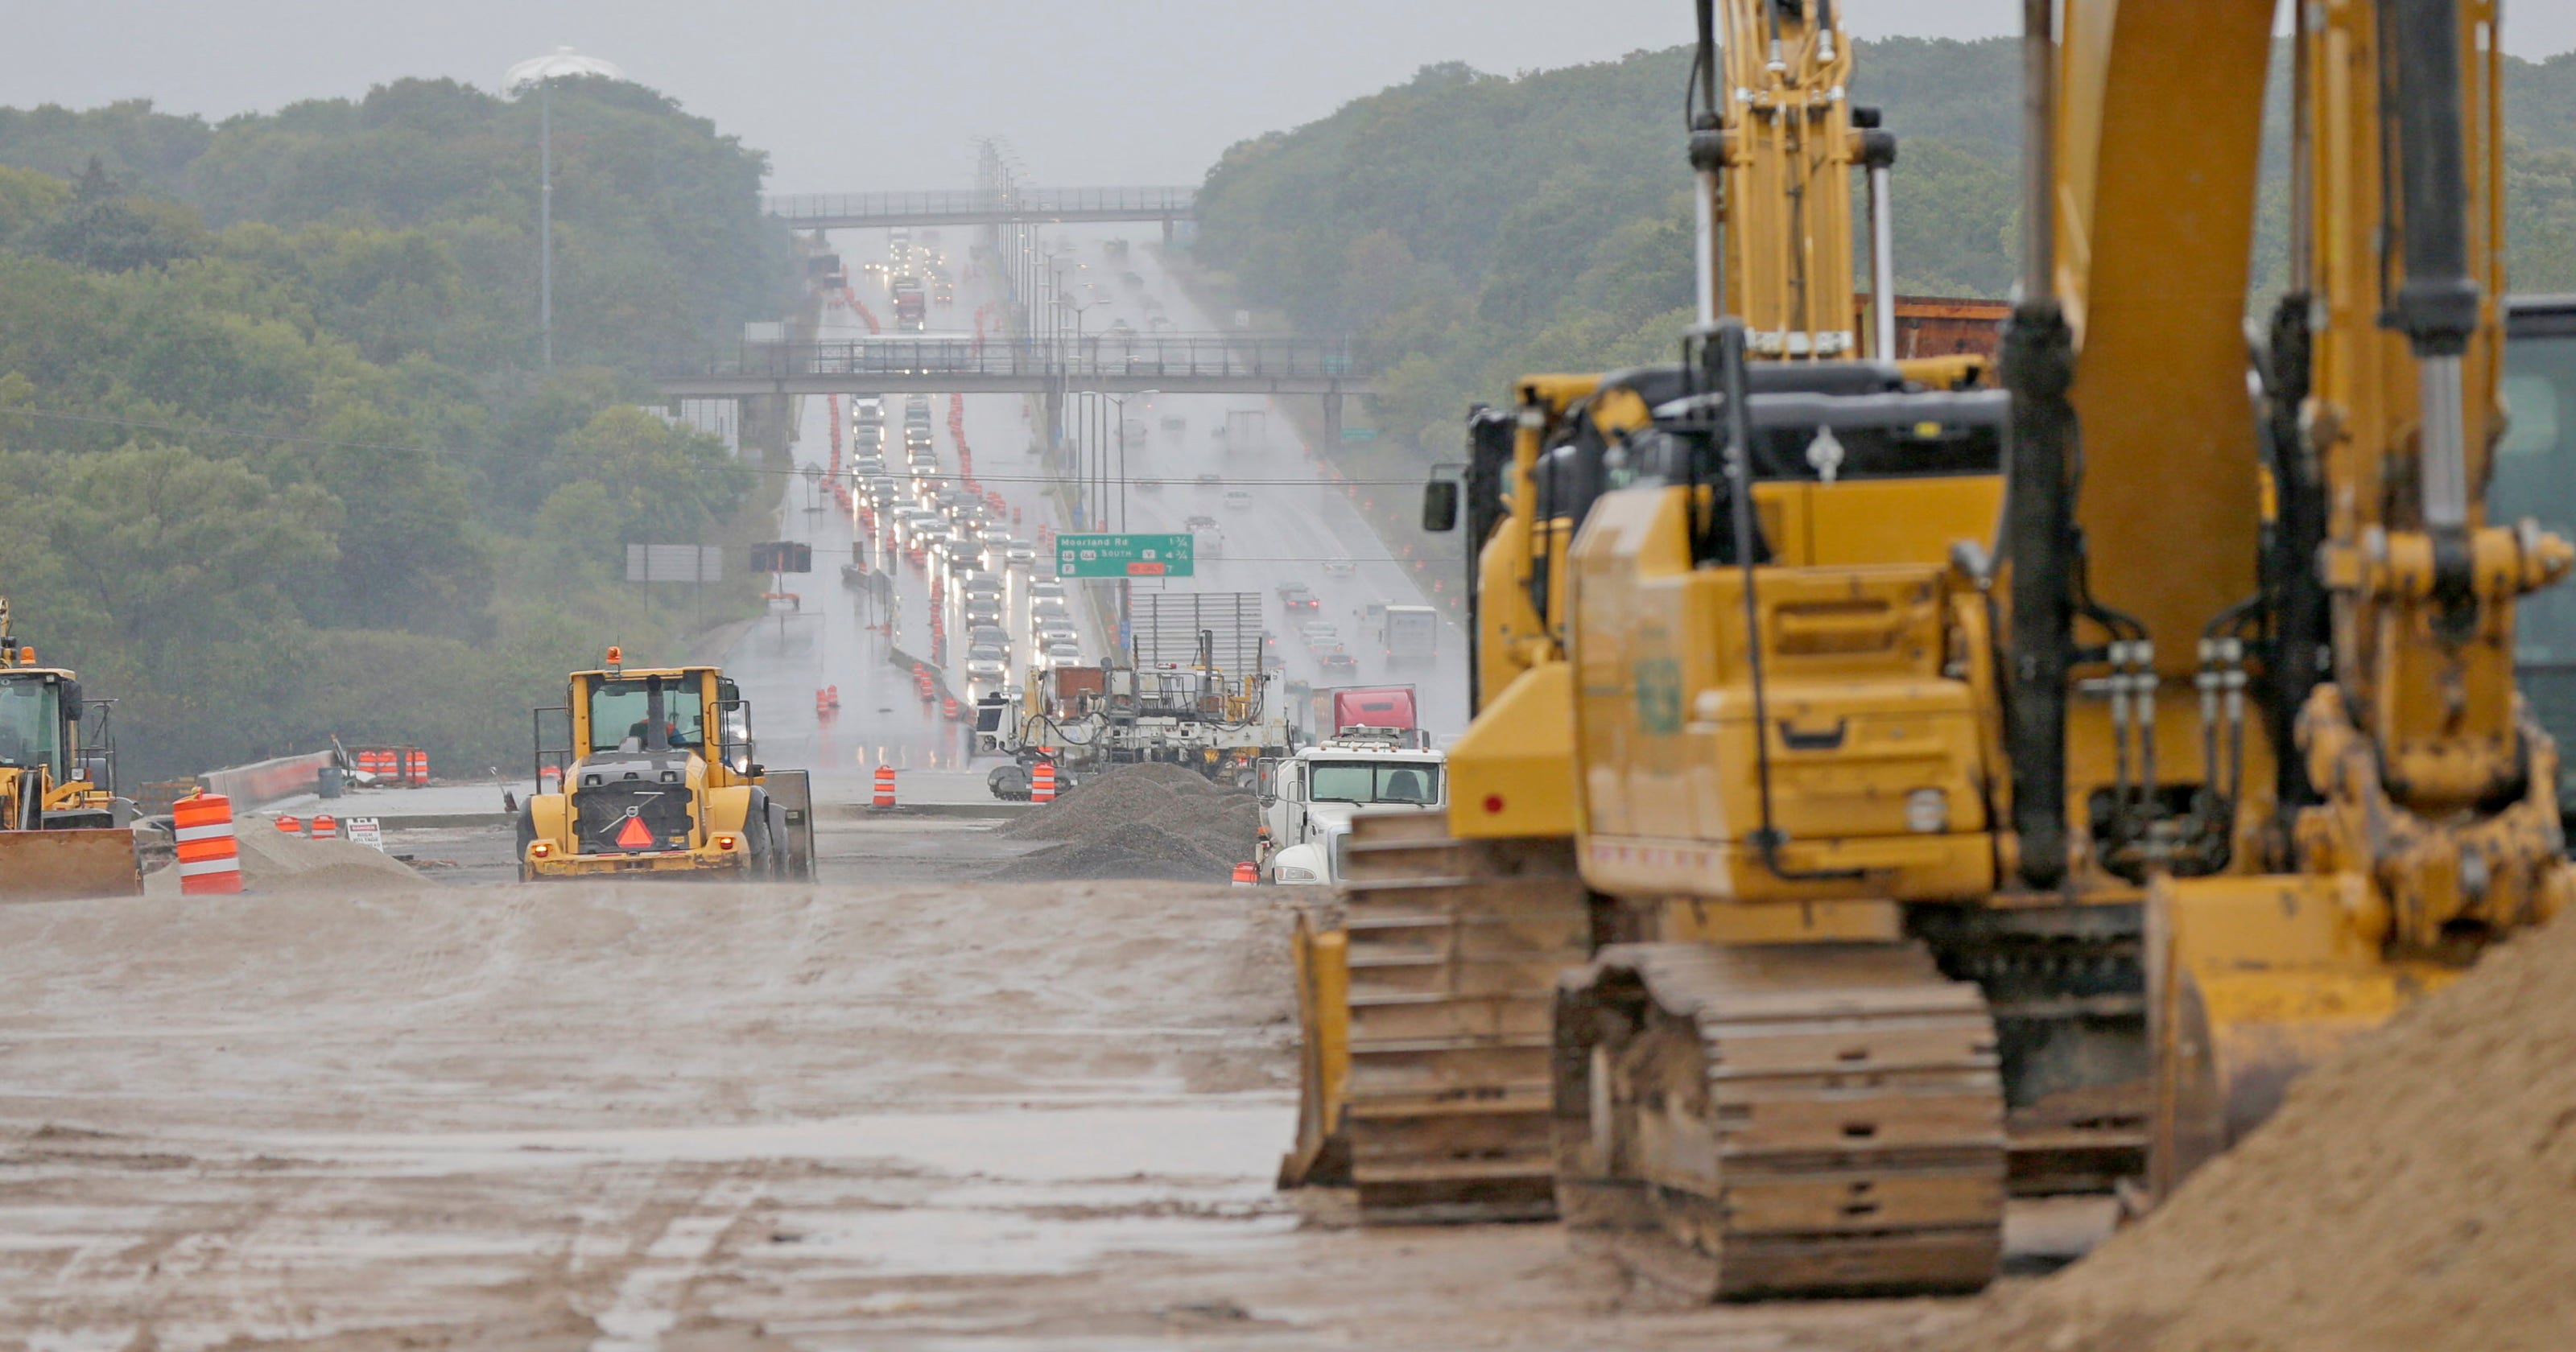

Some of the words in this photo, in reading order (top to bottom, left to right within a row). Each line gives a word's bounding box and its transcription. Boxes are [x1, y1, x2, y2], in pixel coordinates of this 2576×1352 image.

[1061, 538, 1109, 546] Moorland
[1114, 538, 1129, 546] Rd
[1166, 565, 1173, 574] 7
